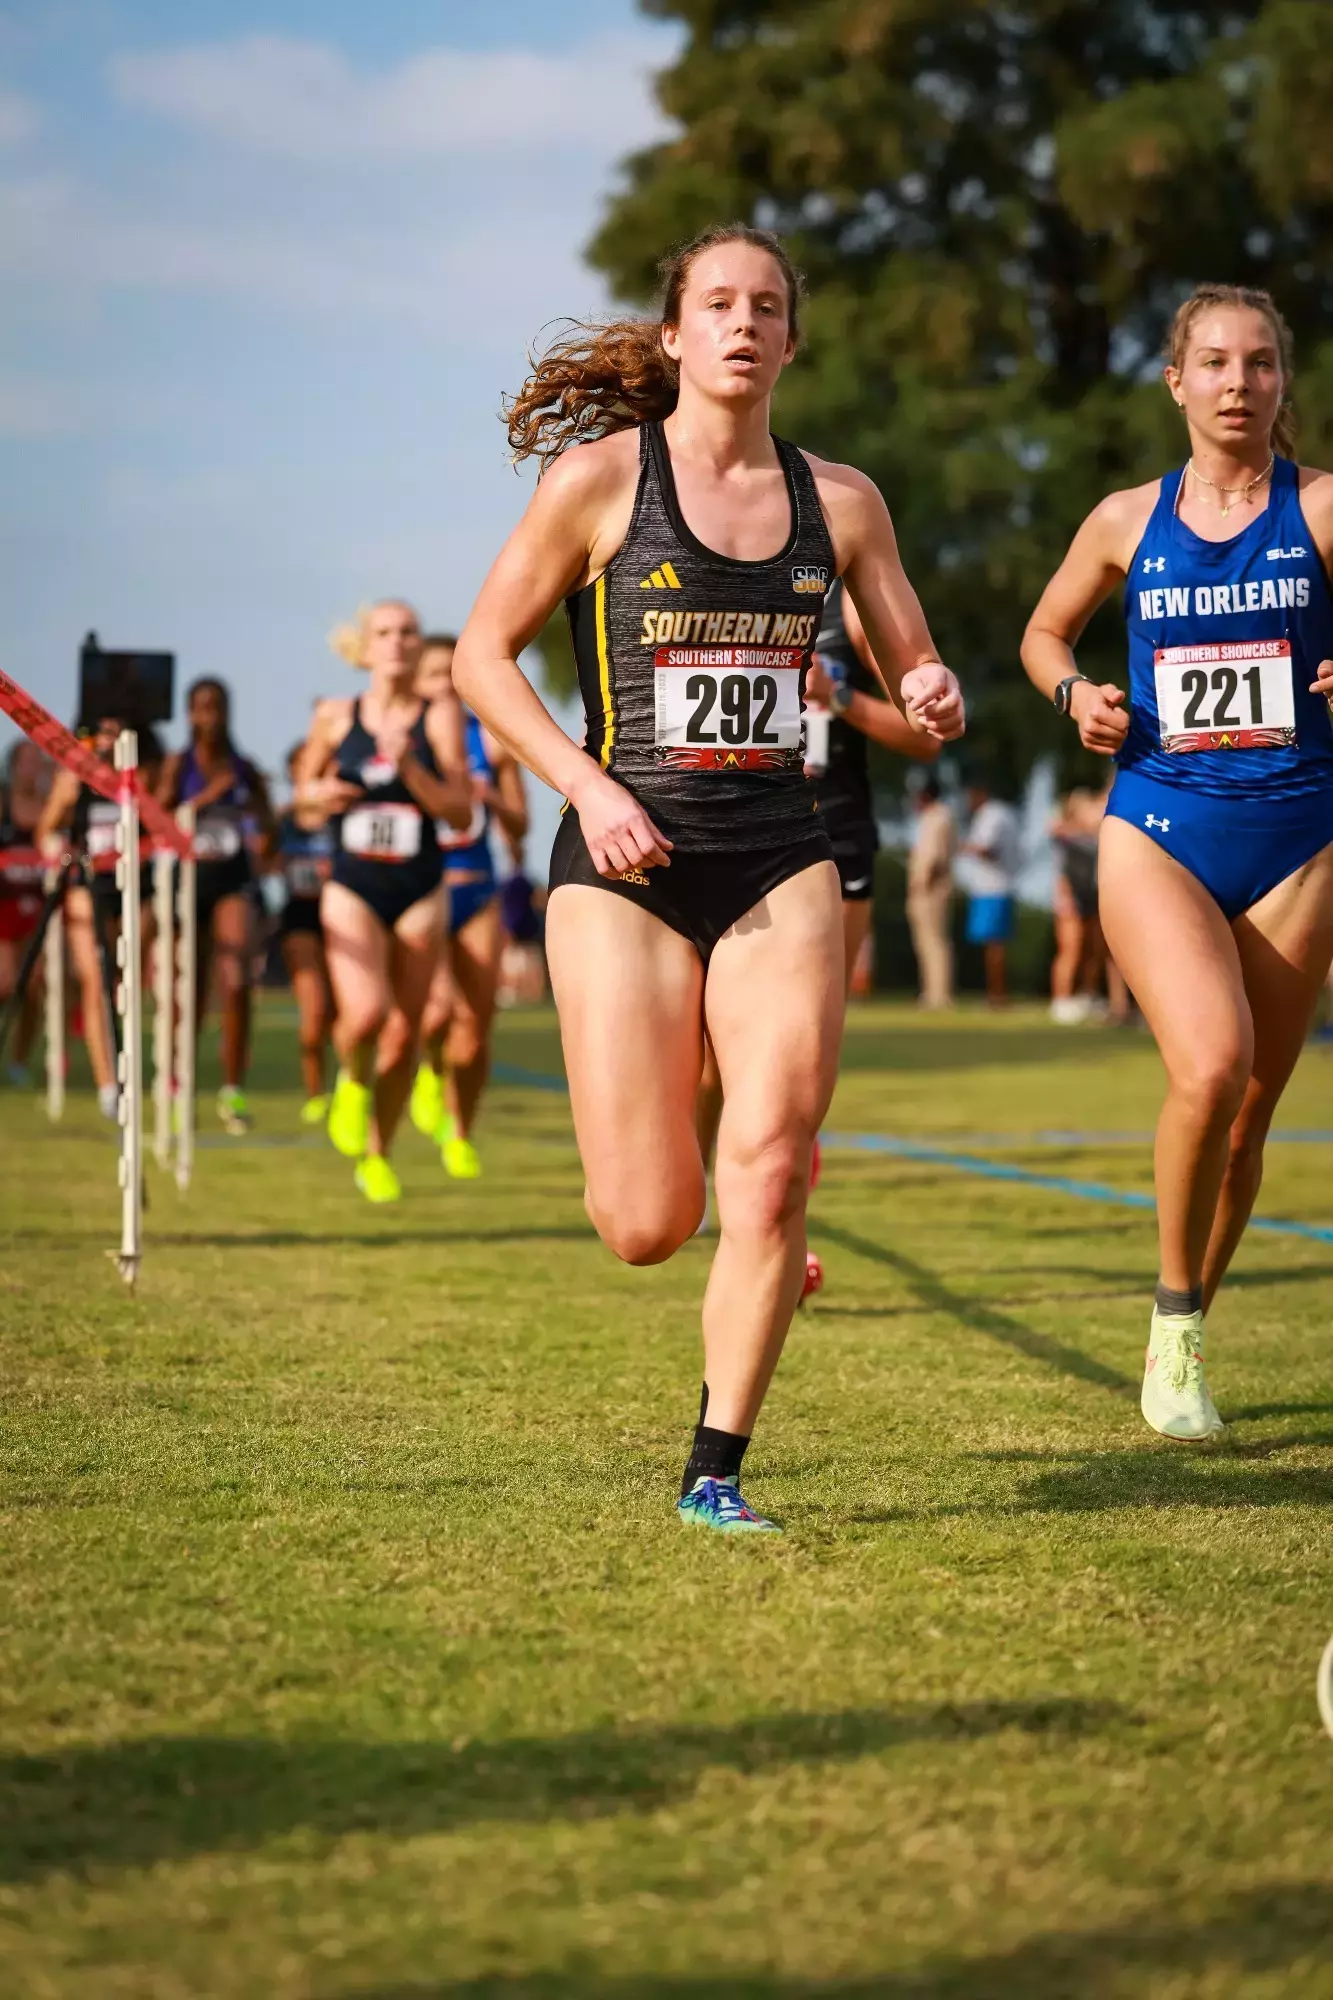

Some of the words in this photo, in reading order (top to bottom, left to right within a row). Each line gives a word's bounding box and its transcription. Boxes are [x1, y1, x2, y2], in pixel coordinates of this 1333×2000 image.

[1139, 587, 1190, 620] NEW
[1195, 578, 1310, 615] ORLEANS
[640, 610, 771, 645] SOUTHERN
[768, 613, 816, 646] MISS
[668, 649, 732, 665] SOUTHERN
[734, 649, 793, 666] SHOWCASE
[1163, 645, 1219, 664] SOUTHERN
[1220, 642, 1280, 660] SHOWCASE
[686, 674, 779, 745] 292
[1181, 666, 1263, 729] 221
[619, 870, 651, 886] idas
